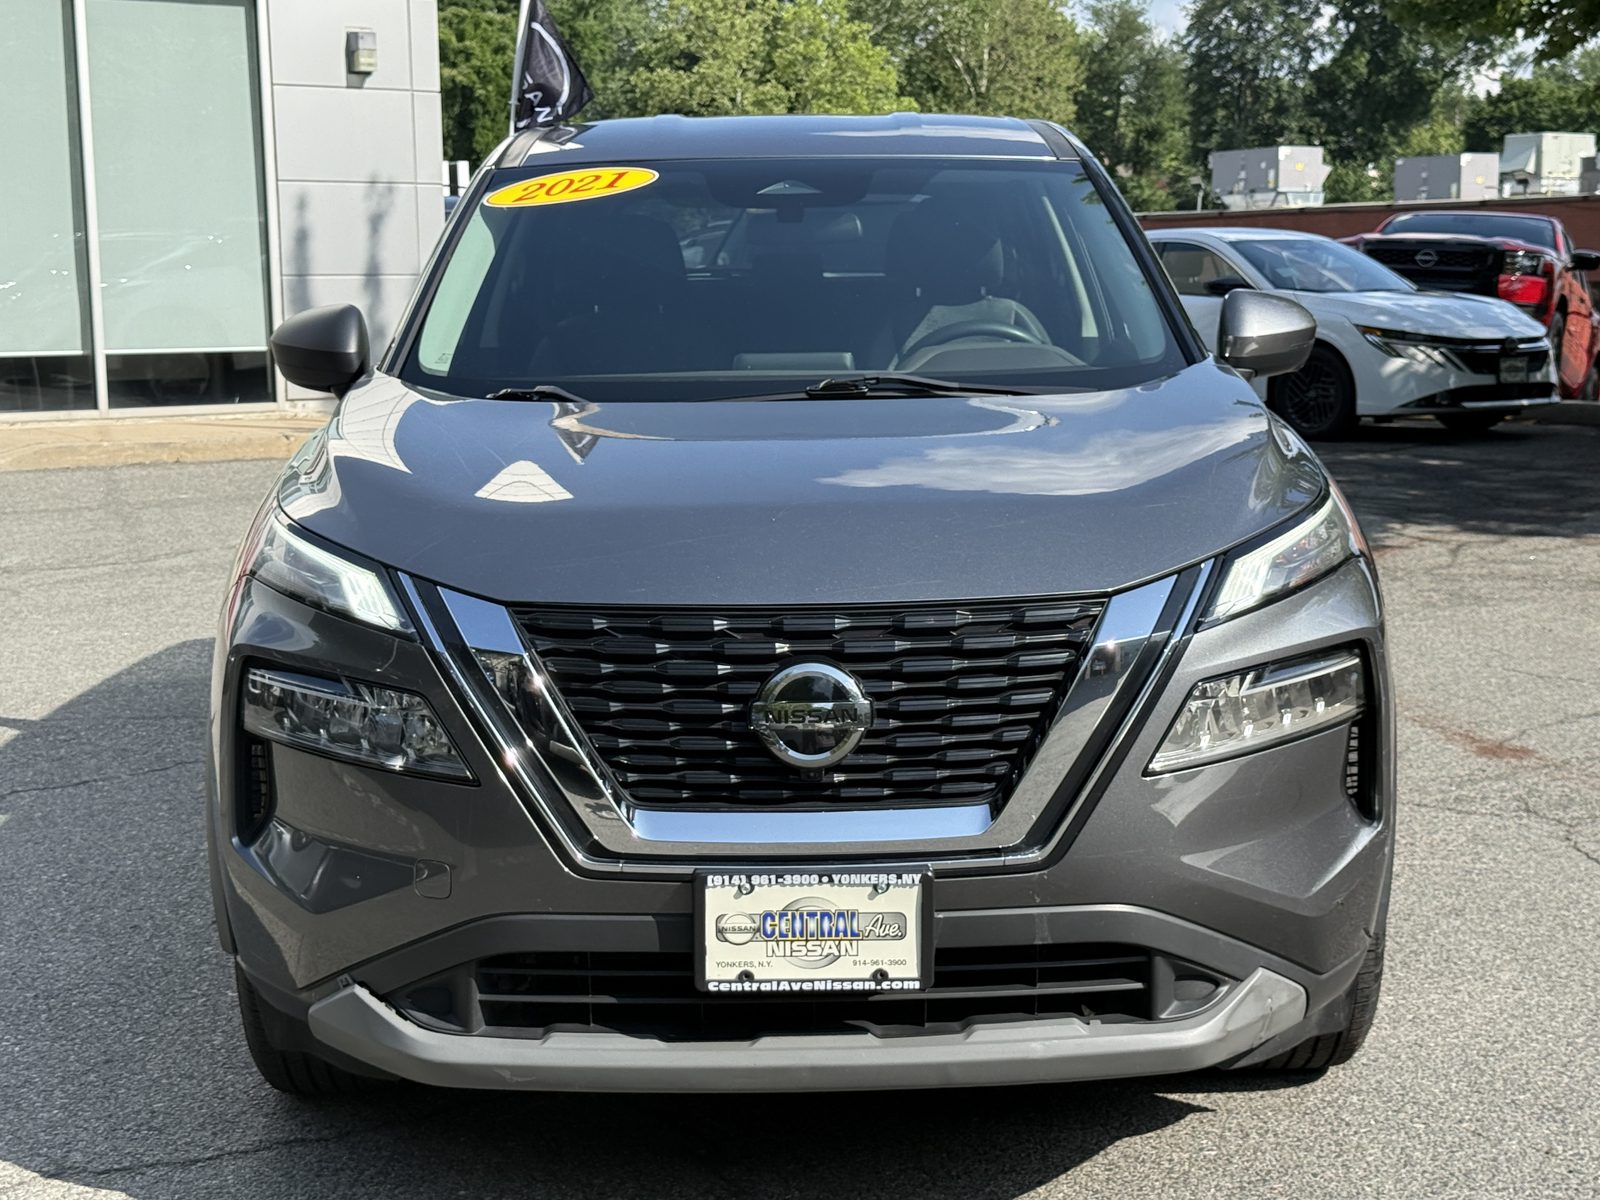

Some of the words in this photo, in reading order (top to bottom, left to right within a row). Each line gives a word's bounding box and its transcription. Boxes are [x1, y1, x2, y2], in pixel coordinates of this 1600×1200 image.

[512, 171, 629, 202] 2021
[764, 709, 858, 723] NISSAN
[751, 874, 819, 885] 961-3900
[761, 910, 863, 940] CENTRAL
[865, 913, 903, 937] Ave.
[766, 940, 858, 957] NISSAN
[715, 961, 757, 969] YONKERS,
[853, 959, 906, 967] 914-961-3900
[708, 980, 920, 992] CentralAveNissan.com
